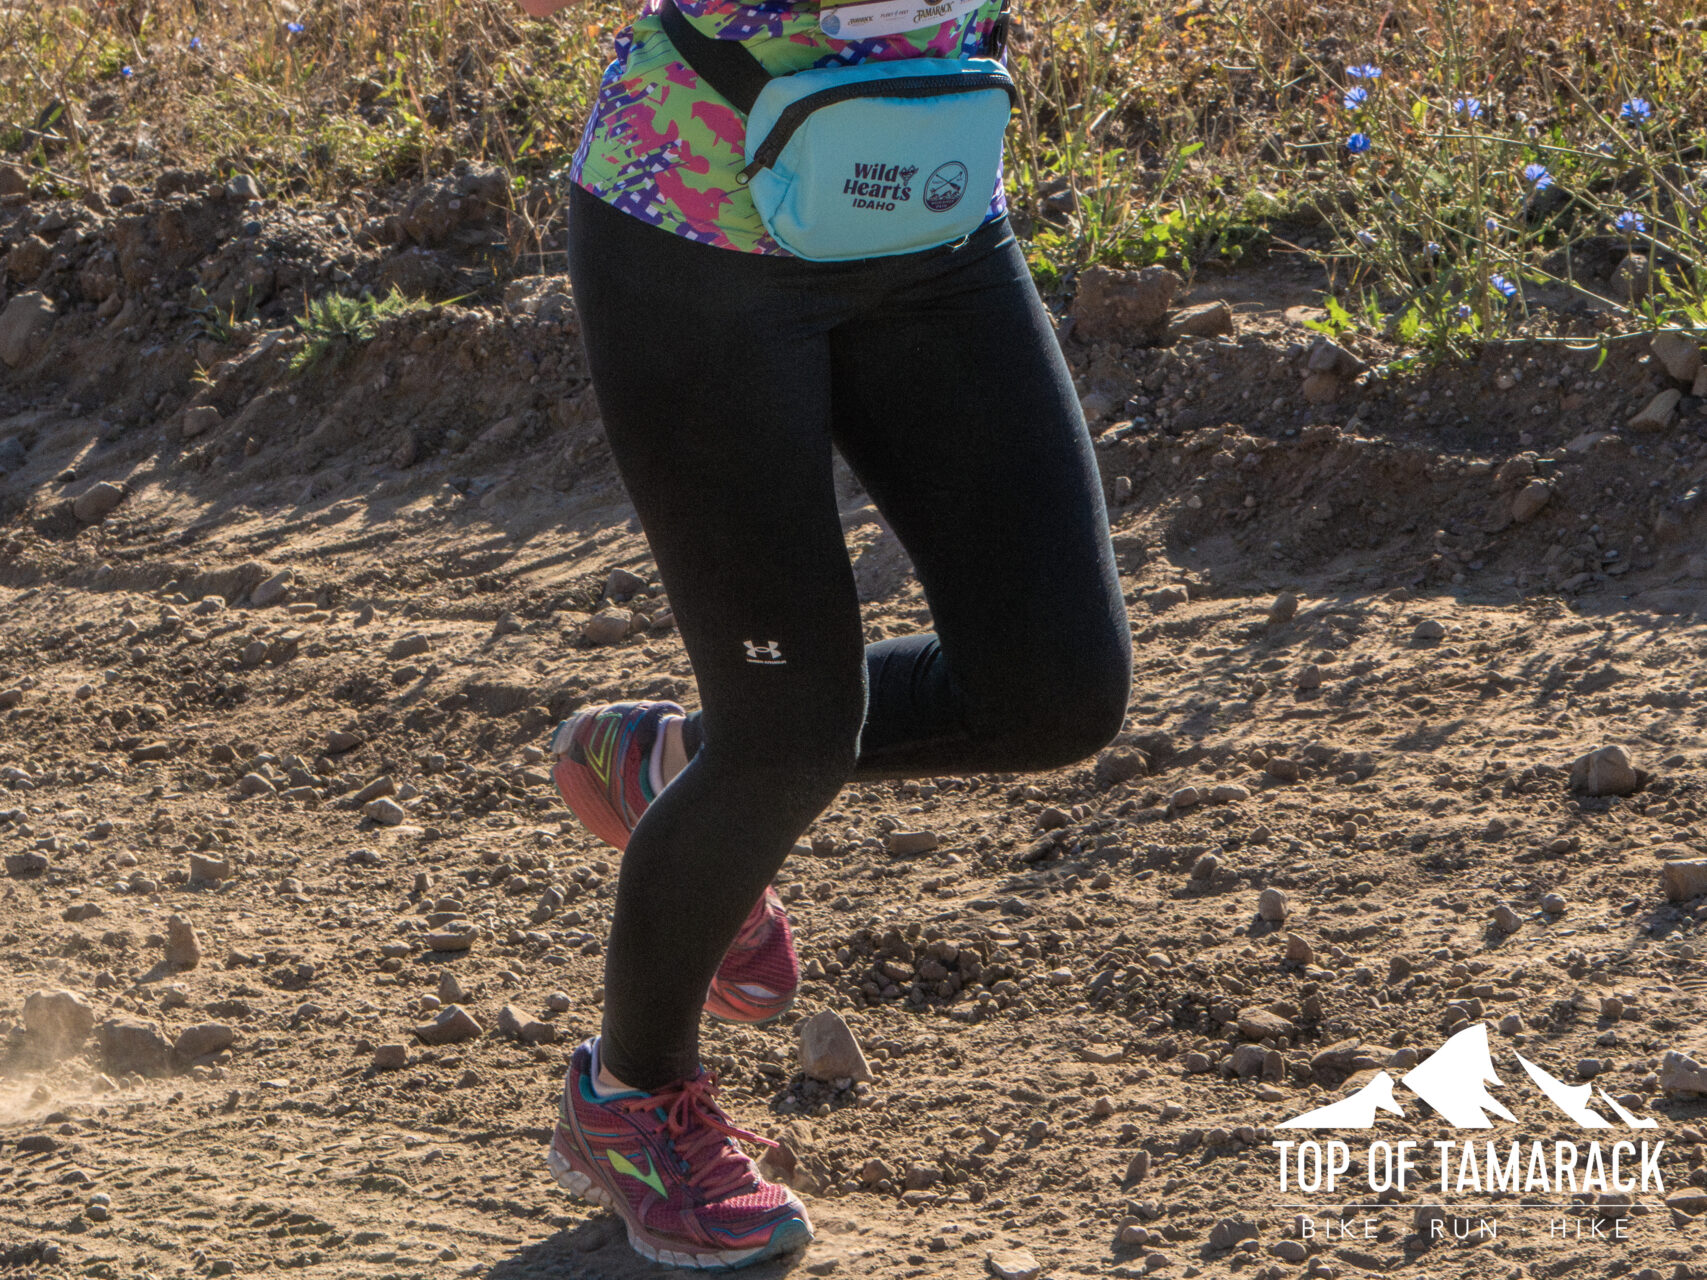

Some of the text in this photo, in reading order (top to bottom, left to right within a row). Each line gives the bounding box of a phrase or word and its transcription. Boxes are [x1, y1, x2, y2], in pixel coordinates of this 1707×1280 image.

[914, 2, 954, 24] TAMARACK
[854, 162, 900, 182] Wild
[843, 179, 912, 201] Hearts
[852, 198, 895, 211] IDAHO
